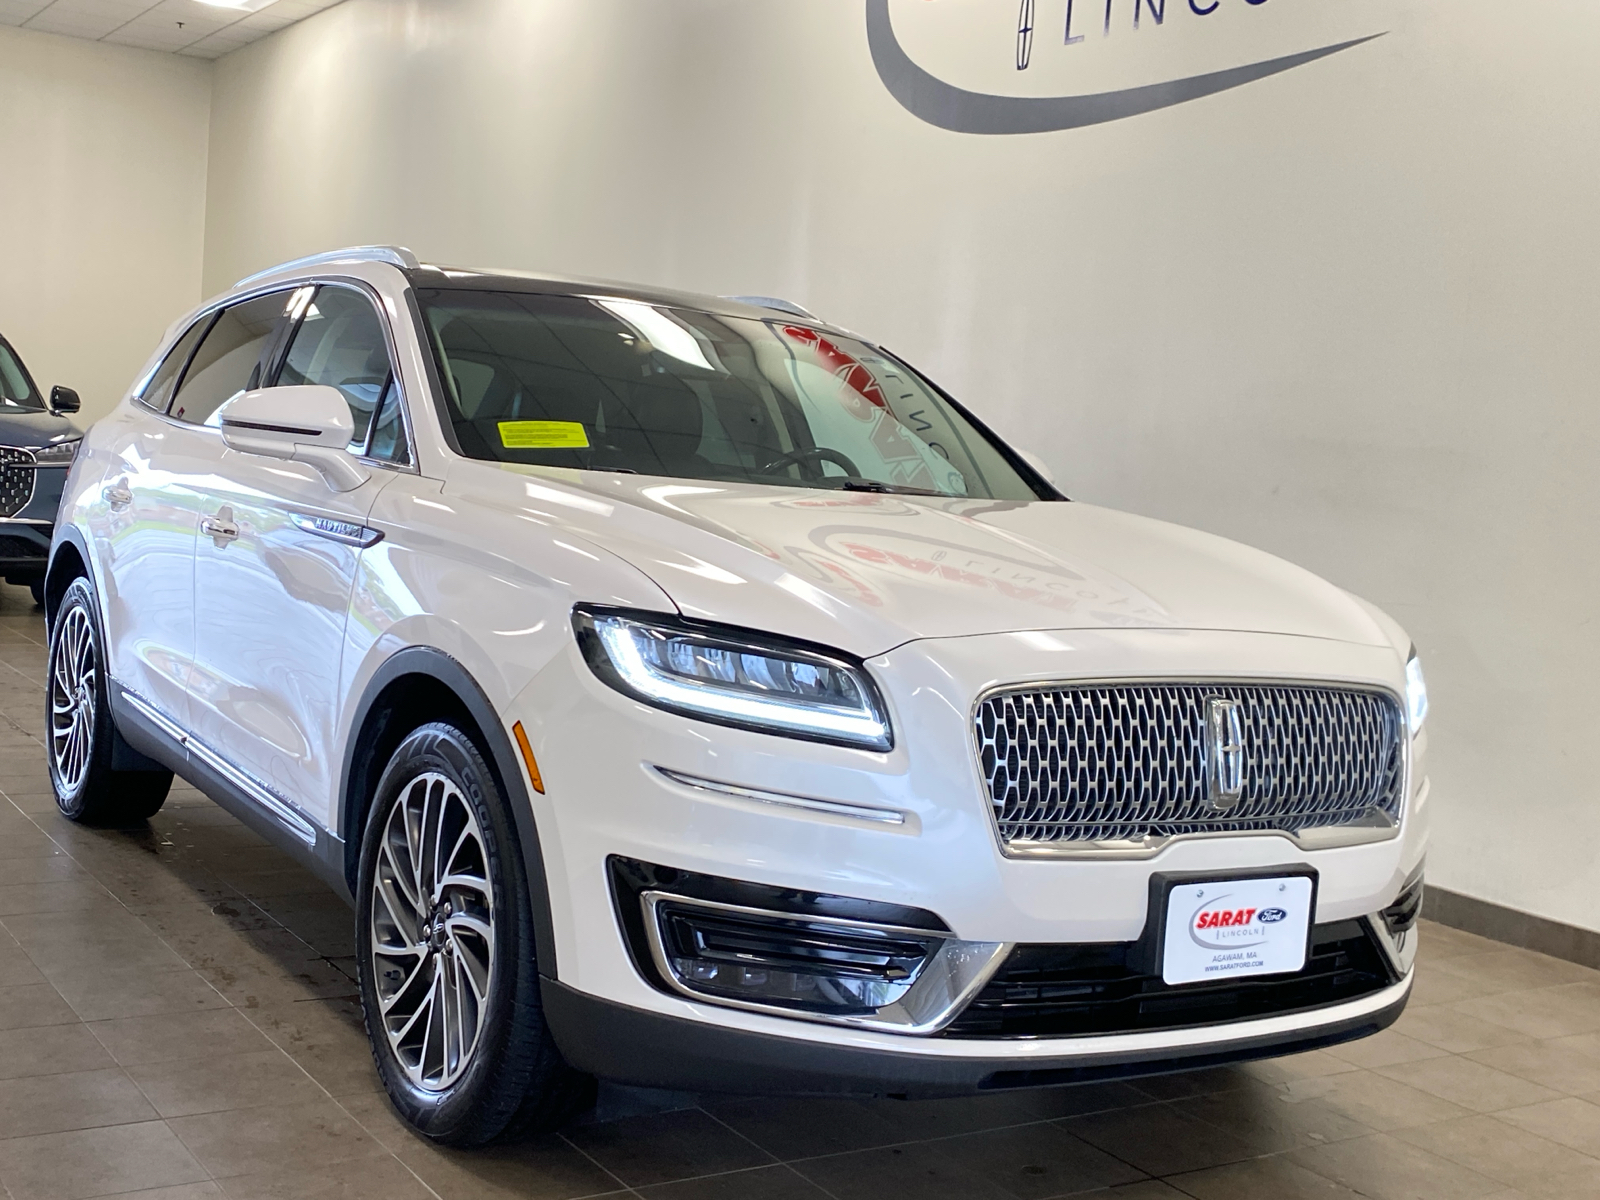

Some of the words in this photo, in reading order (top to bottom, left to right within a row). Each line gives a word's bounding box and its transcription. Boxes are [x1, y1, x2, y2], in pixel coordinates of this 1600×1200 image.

[1064, 0, 1268, 45] LIN
[1196, 908, 1257, 929] SARAT
[1261, 909, 1283, 921] Ford
[1222, 929, 1259, 938] LINCOLN
[1212, 953, 1245, 962] AGAWAM,
[1246, 951, 1257, 959] MA
[1204, 961, 1264, 972] WWW.SARATFORD.COM
